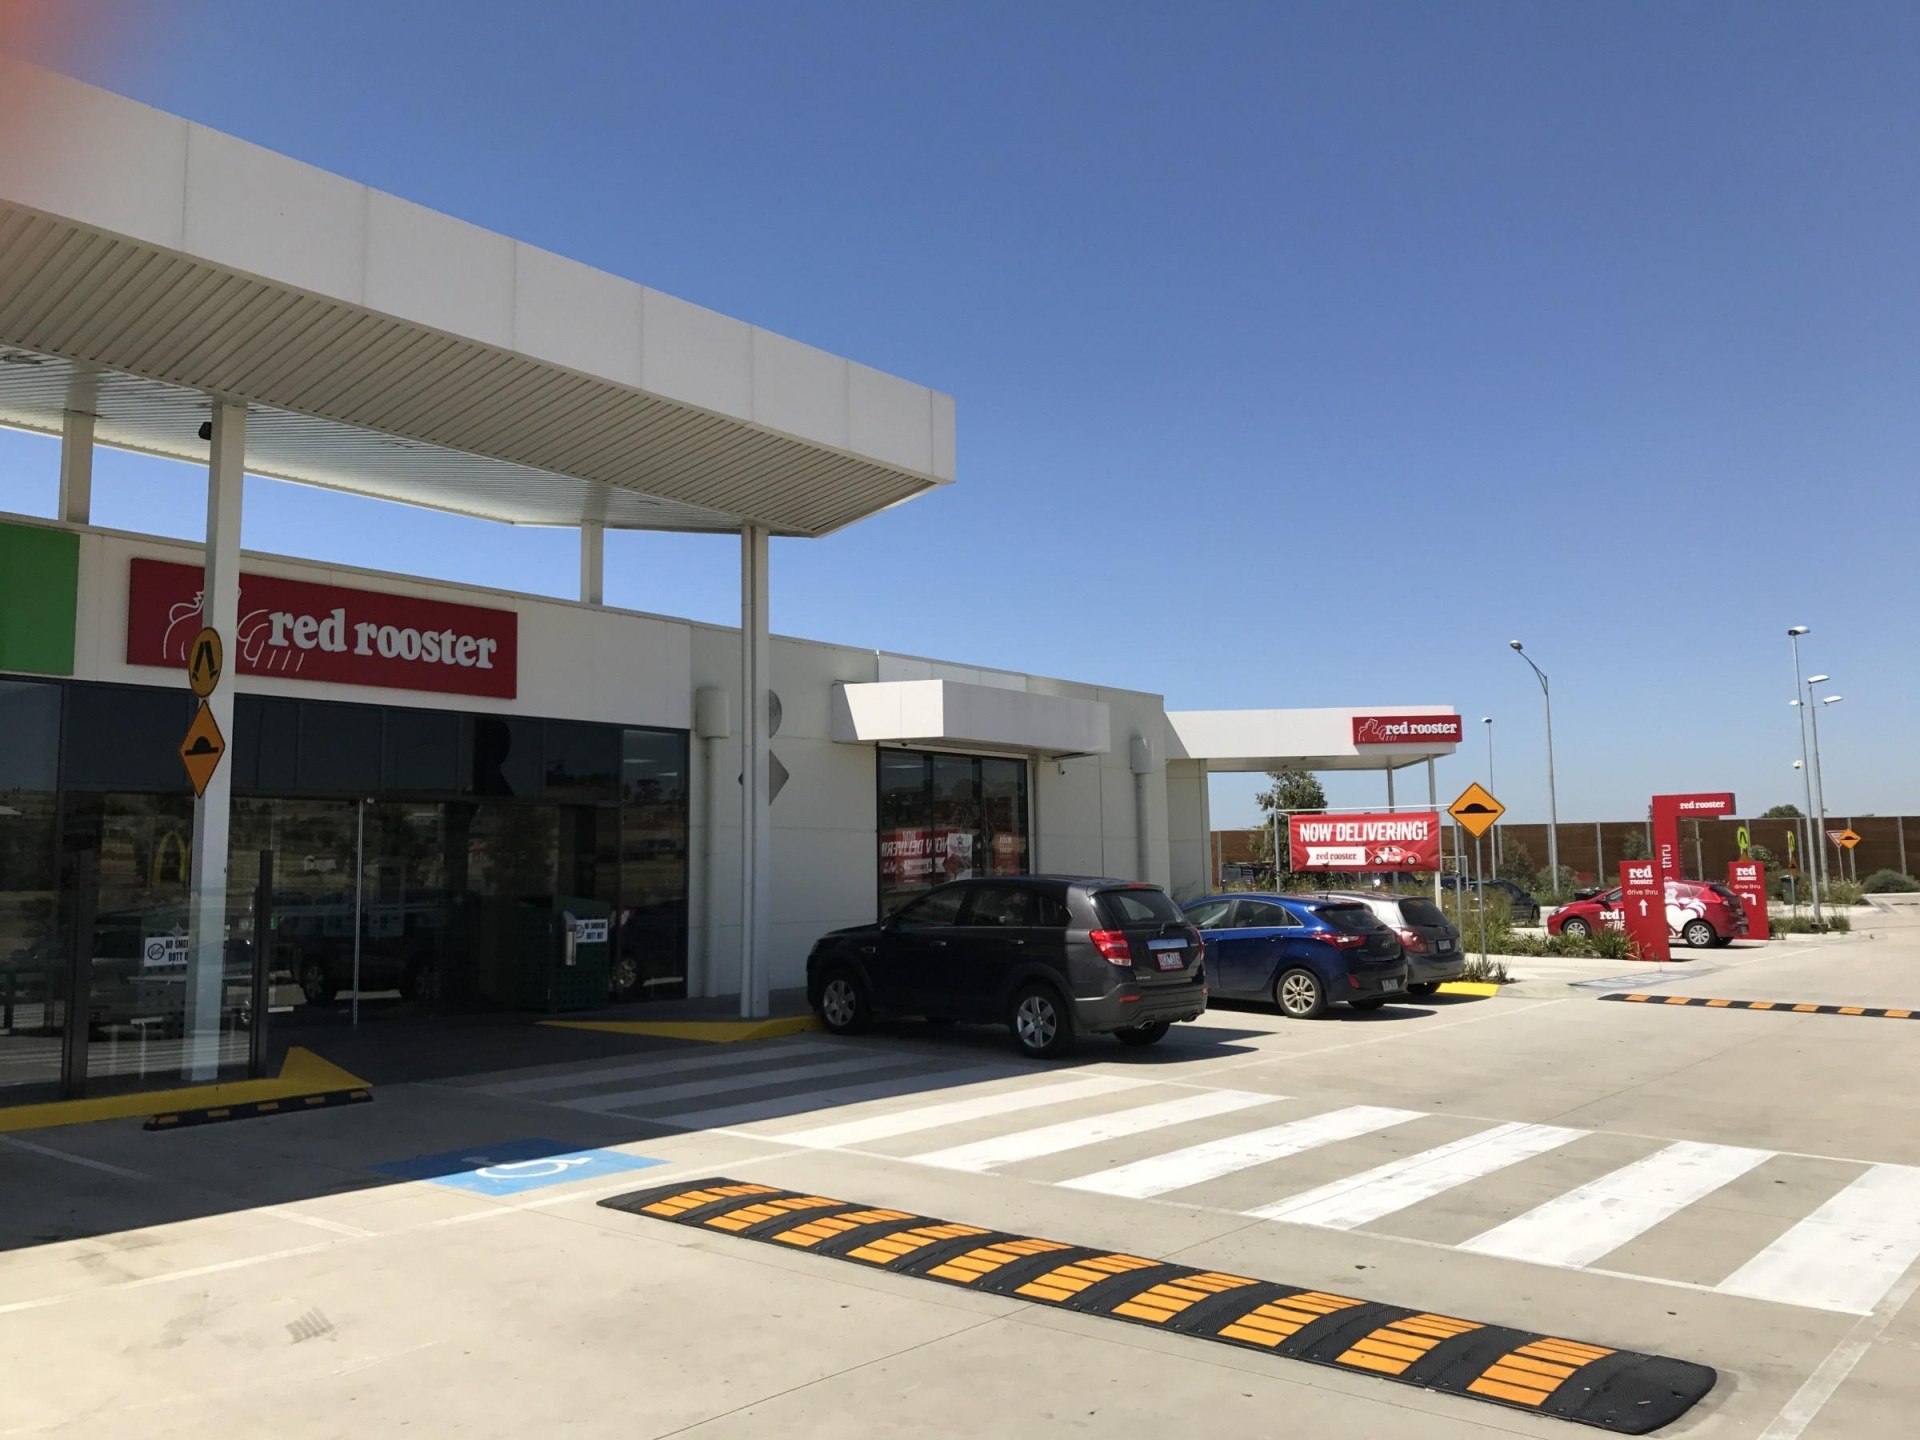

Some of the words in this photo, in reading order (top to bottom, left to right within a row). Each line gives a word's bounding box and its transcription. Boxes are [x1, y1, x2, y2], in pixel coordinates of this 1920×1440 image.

[268, 608, 347, 652] red
[354, 622, 497, 669] rooster
[1385, 721, 1408, 735] red
[1410, 723, 1457, 735] rooster
[1680, 800, 1694, 809] red
[1696, 801, 1725, 809] rooster
[1299, 823, 1333, 842] NOW
[1335, 821, 1428, 842] DELIVERING!
[1316, 851, 1328, 860] red
[1330, 852, 1357, 860] rooster
[1661, 844, 1672, 869] thru
[1628, 865, 1653, 879] red
[1736, 865, 1757, 876] red
[1599, 908, 1620, 920] red
[166, 940, 173, 949] NO
